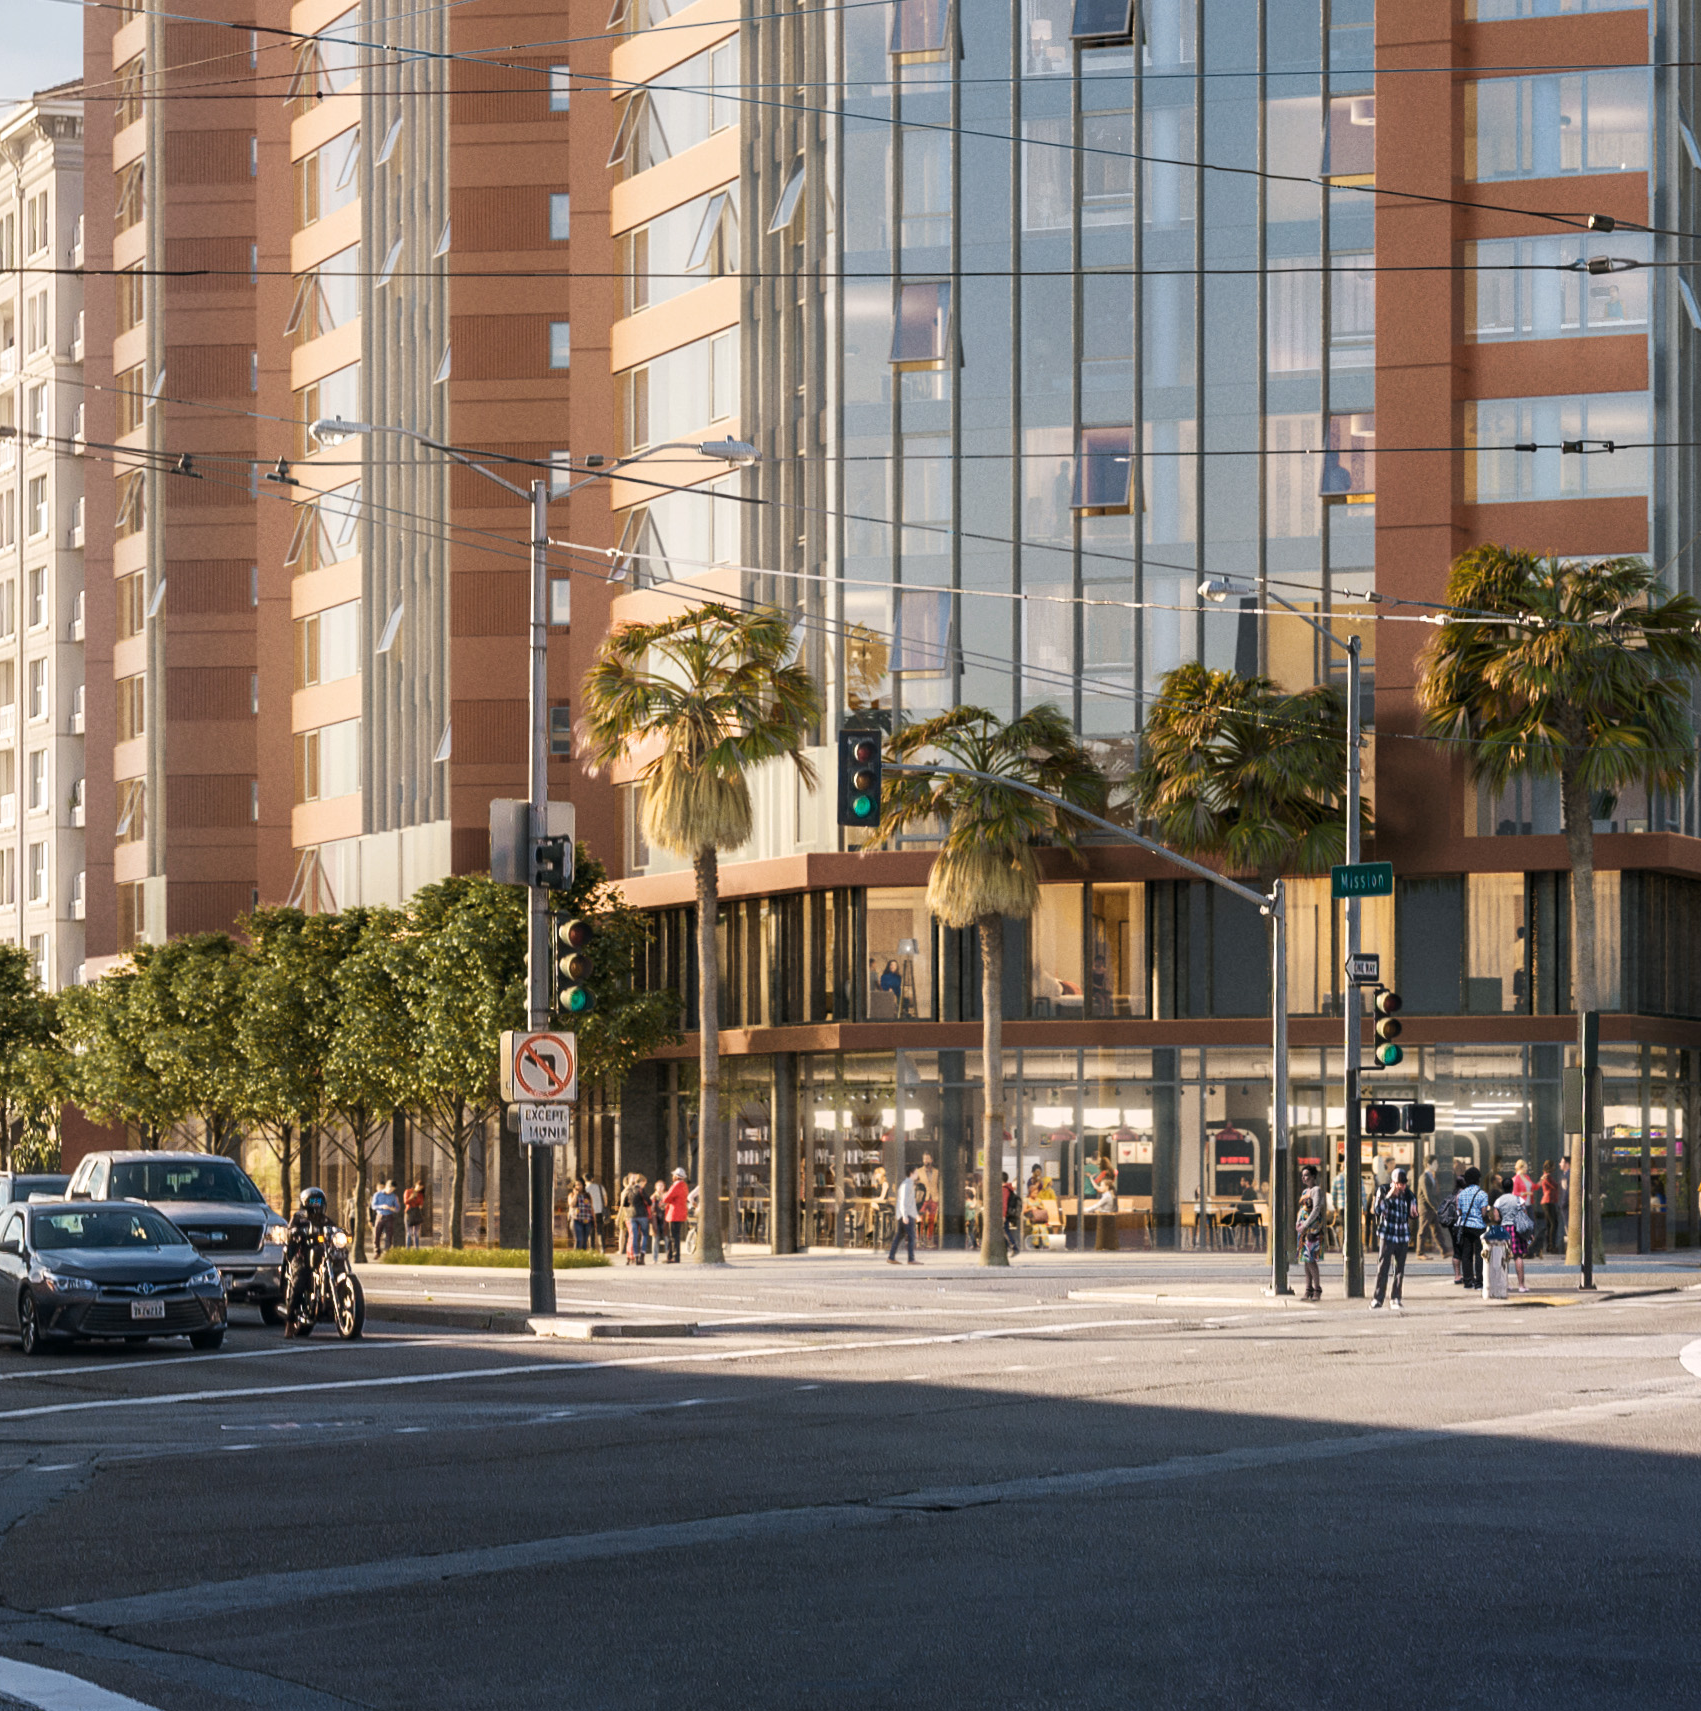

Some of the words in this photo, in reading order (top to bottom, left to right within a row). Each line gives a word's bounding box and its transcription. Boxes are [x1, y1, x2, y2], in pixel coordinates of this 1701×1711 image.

[1341, 871, 1384, 890] Mission
[525, 1109, 565, 1123] EXCEPT
[529, 1126, 560, 1139] MUNI
